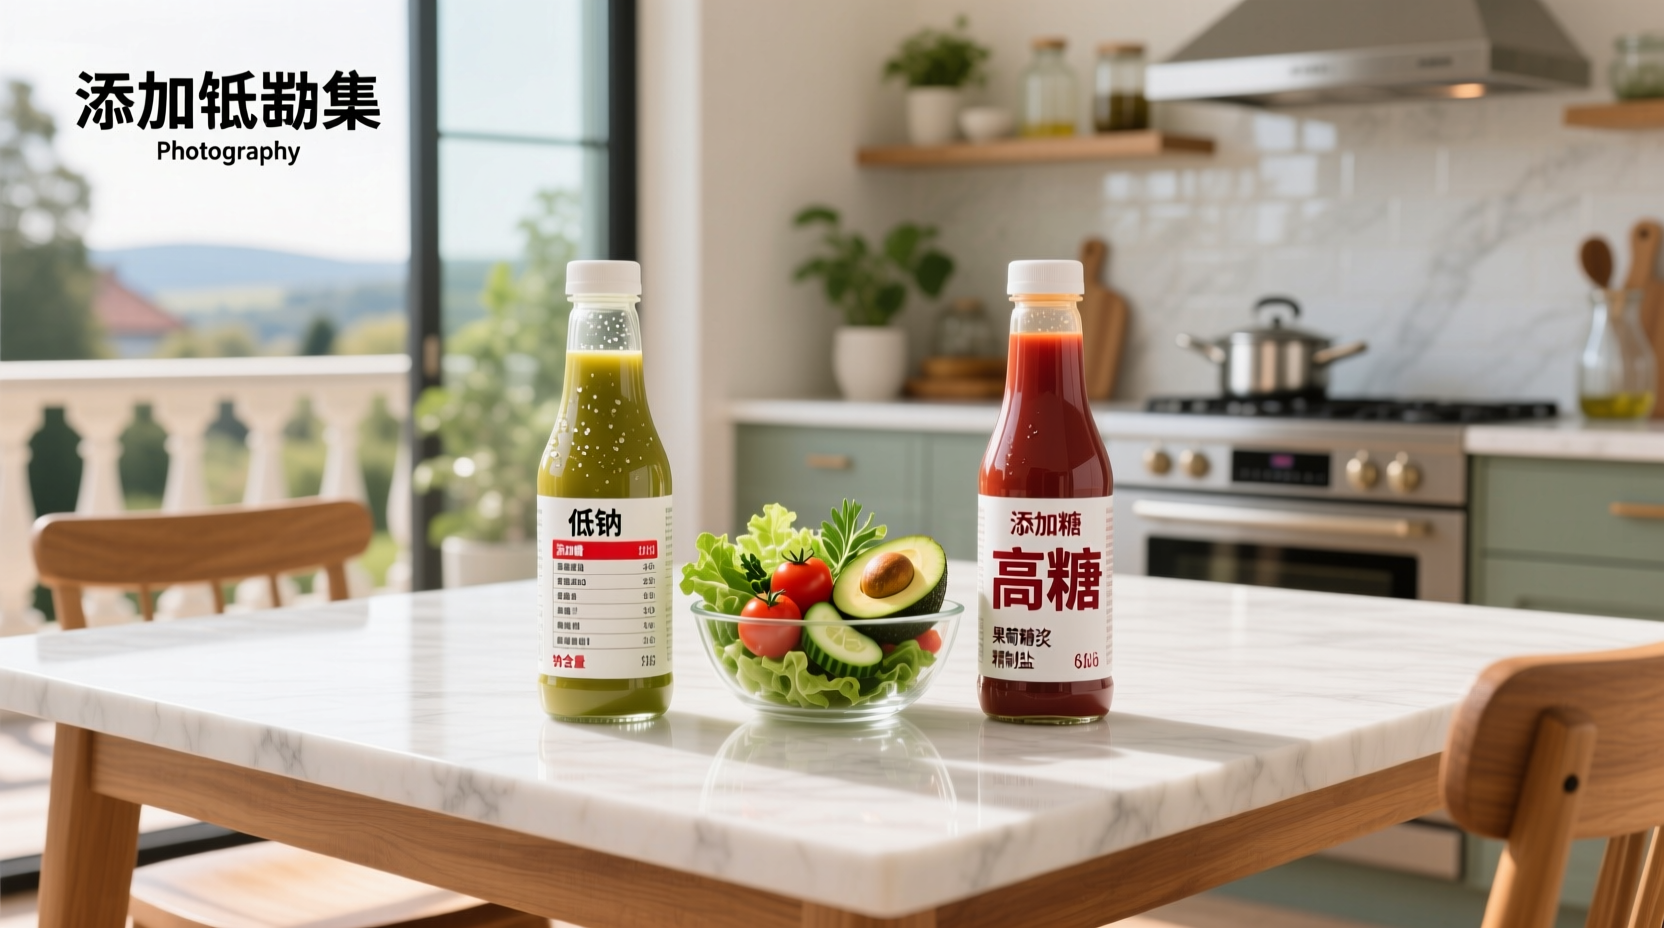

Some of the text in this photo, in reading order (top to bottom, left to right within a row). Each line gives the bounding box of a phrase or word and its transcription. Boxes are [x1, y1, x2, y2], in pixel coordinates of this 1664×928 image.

[568, 508, 622, 537] 低钠
[1010, 511, 1081, 536] 添加糖
[993, 547, 1102, 612] 高糖
